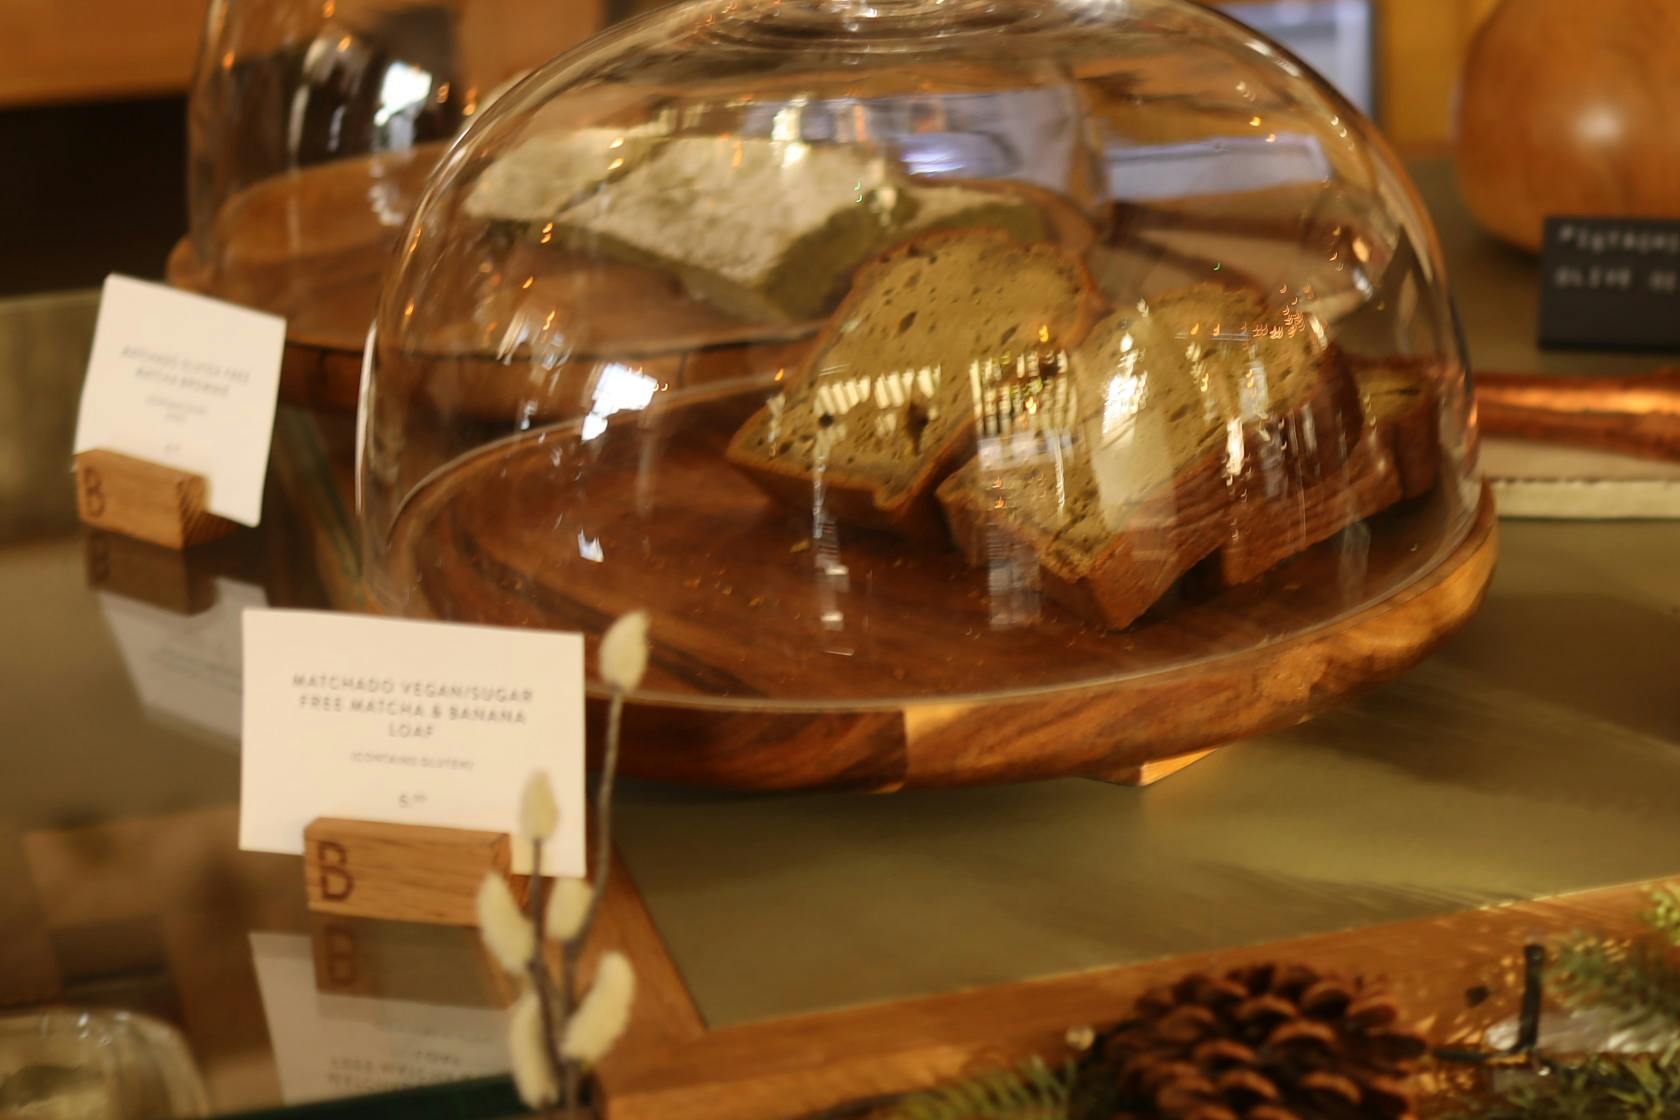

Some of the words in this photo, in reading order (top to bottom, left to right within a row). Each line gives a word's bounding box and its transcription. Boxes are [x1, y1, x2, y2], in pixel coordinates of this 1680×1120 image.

[292, 673, 394, 694] MATCHADO
[400, 680, 534, 703] VEGAN/SUGAR
[299, 695, 342, 713] FREE
[350, 698, 423, 717] MATCHA
[431, 705, 442, 720] &
[448, 705, 527, 724] BANANA
[388, 723, 434, 738] LOAF
[317, 840, 354, 902] B
